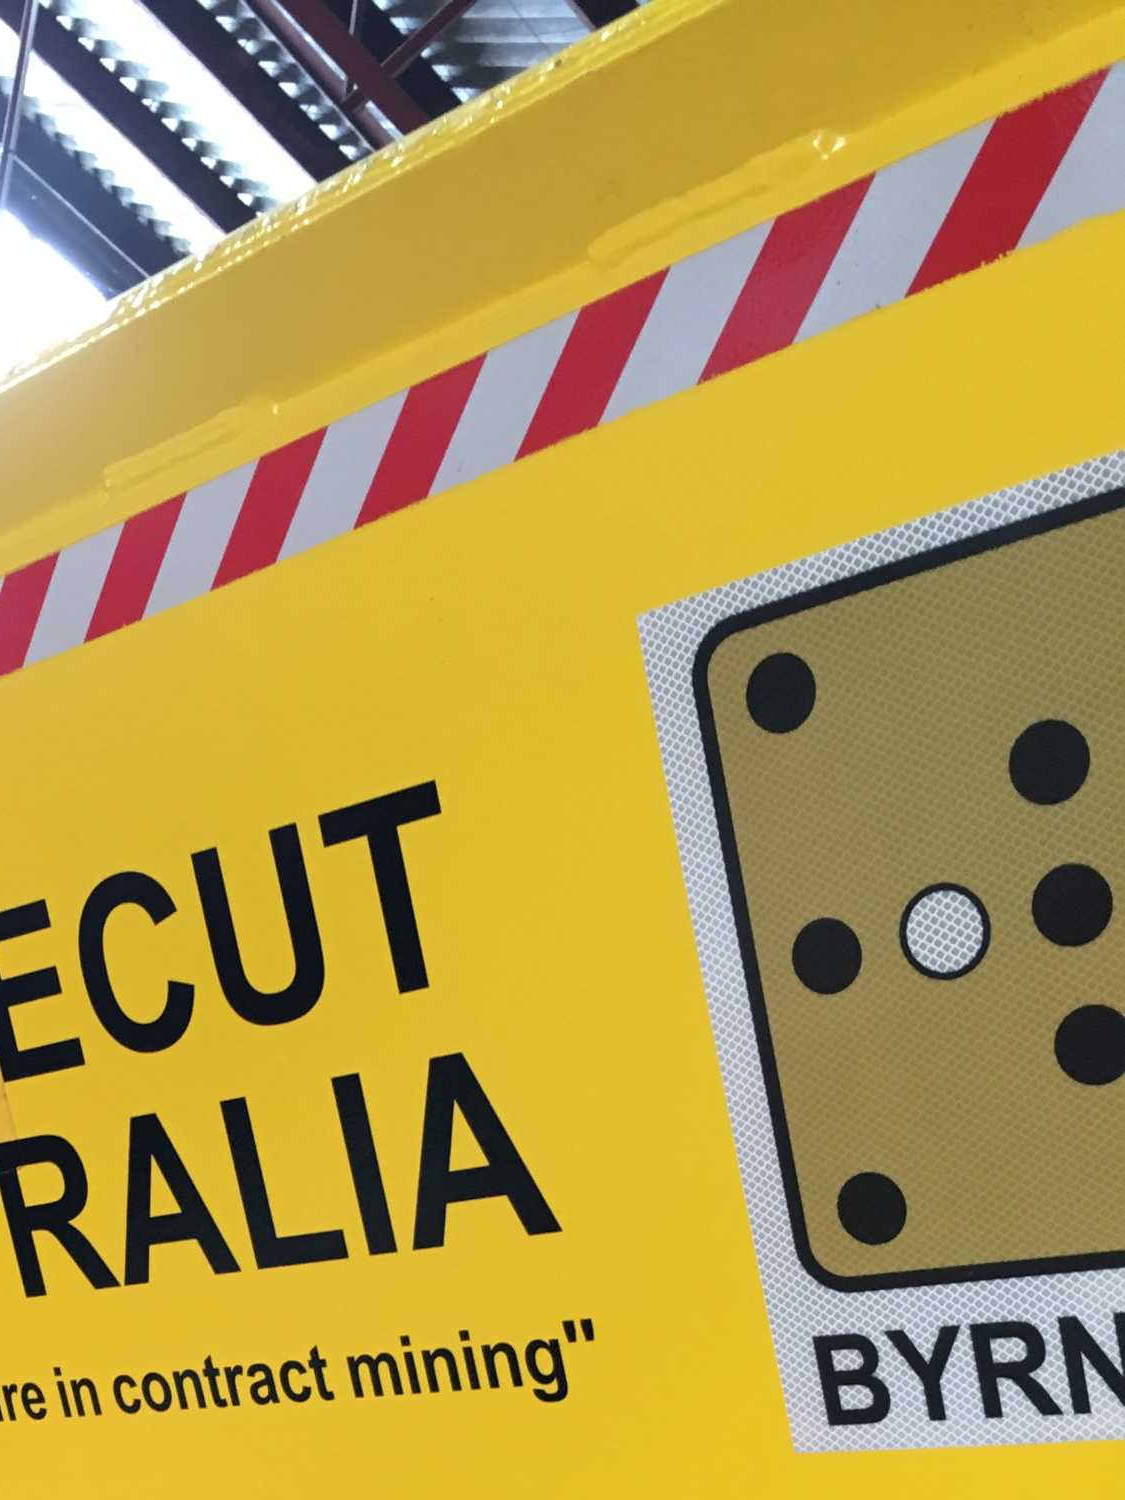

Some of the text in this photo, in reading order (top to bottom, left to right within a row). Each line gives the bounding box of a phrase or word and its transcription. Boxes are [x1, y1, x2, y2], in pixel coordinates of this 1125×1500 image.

[51, 1369, 102, 1419] in
[113, 1346, 335, 1414] contract
[346, 1318, 595, 1404] mining"
